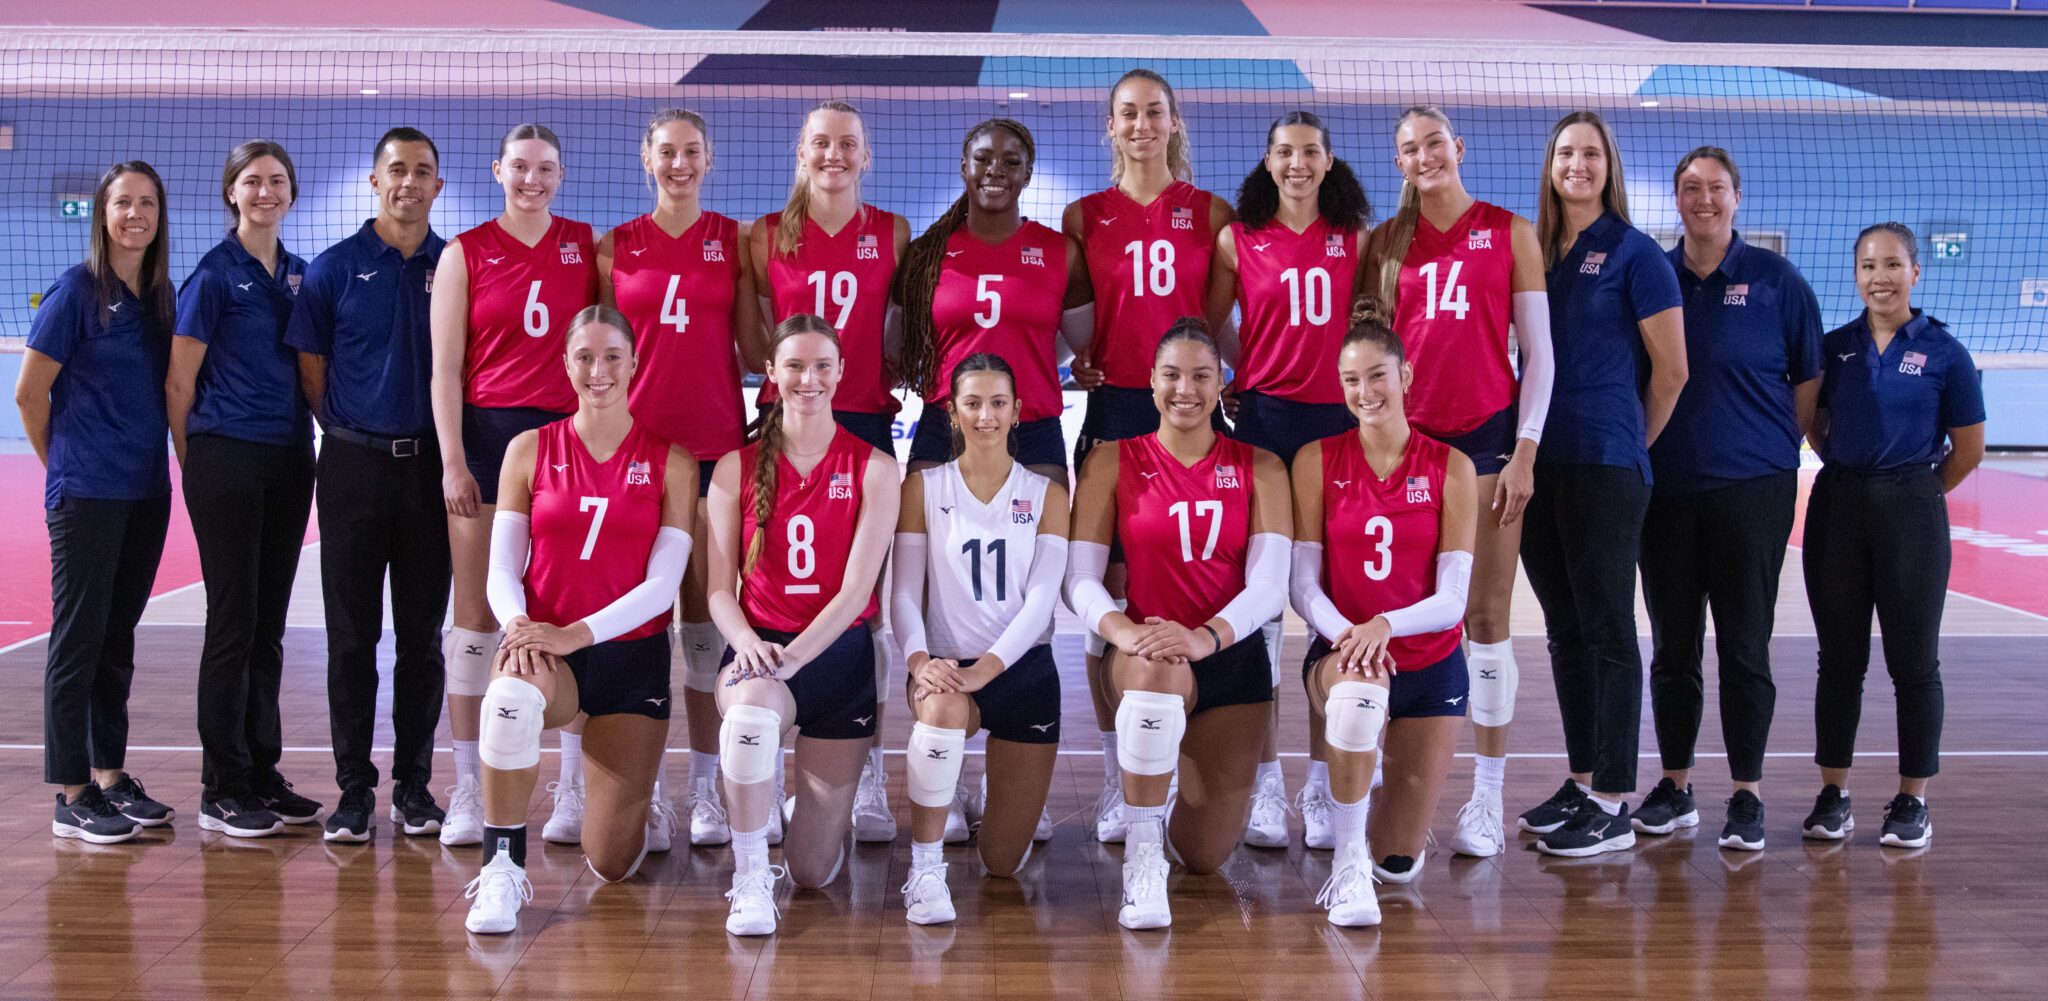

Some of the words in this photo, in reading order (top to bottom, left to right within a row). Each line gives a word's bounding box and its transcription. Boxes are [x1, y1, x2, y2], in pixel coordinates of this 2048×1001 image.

[1172, 217, 1194, 230] USA
[1469, 239, 1491, 250] USA
[704, 251, 726, 262] USA
[857, 248, 879, 260] USA
[1326, 246, 1346, 258] USA
[561, 254, 583, 265] USA
[1022, 256, 1045, 268] USA
[1125, 240, 1175, 297] 18
[1580, 263, 1601, 275] USA
[1281, 267, 1331, 326] 10
[1419, 261, 1470, 320] 14
[660, 274, 690, 333] 4
[807, 271, 858, 329] 19
[973, 275, 1004, 329] 5
[1724, 295, 1747, 306] USA
[524, 281, 550, 338] 6
[1899, 362, 1922, 377] USA
[627, 473, 651, 485] USA
[1216, 477, 1240, 489] USA
[829, 487, 853, 500] USA
[1407, 490, 1432, 504] USA
[1013, 511, 1034, 524] USA
[580, 496, 609, 561] 7
[1169, 500, 1224, 563] 17
[787, 515, 816, 579] 8
[1363, 516, 1394, 580] 3
[962, 539, 1006, 601] 11
